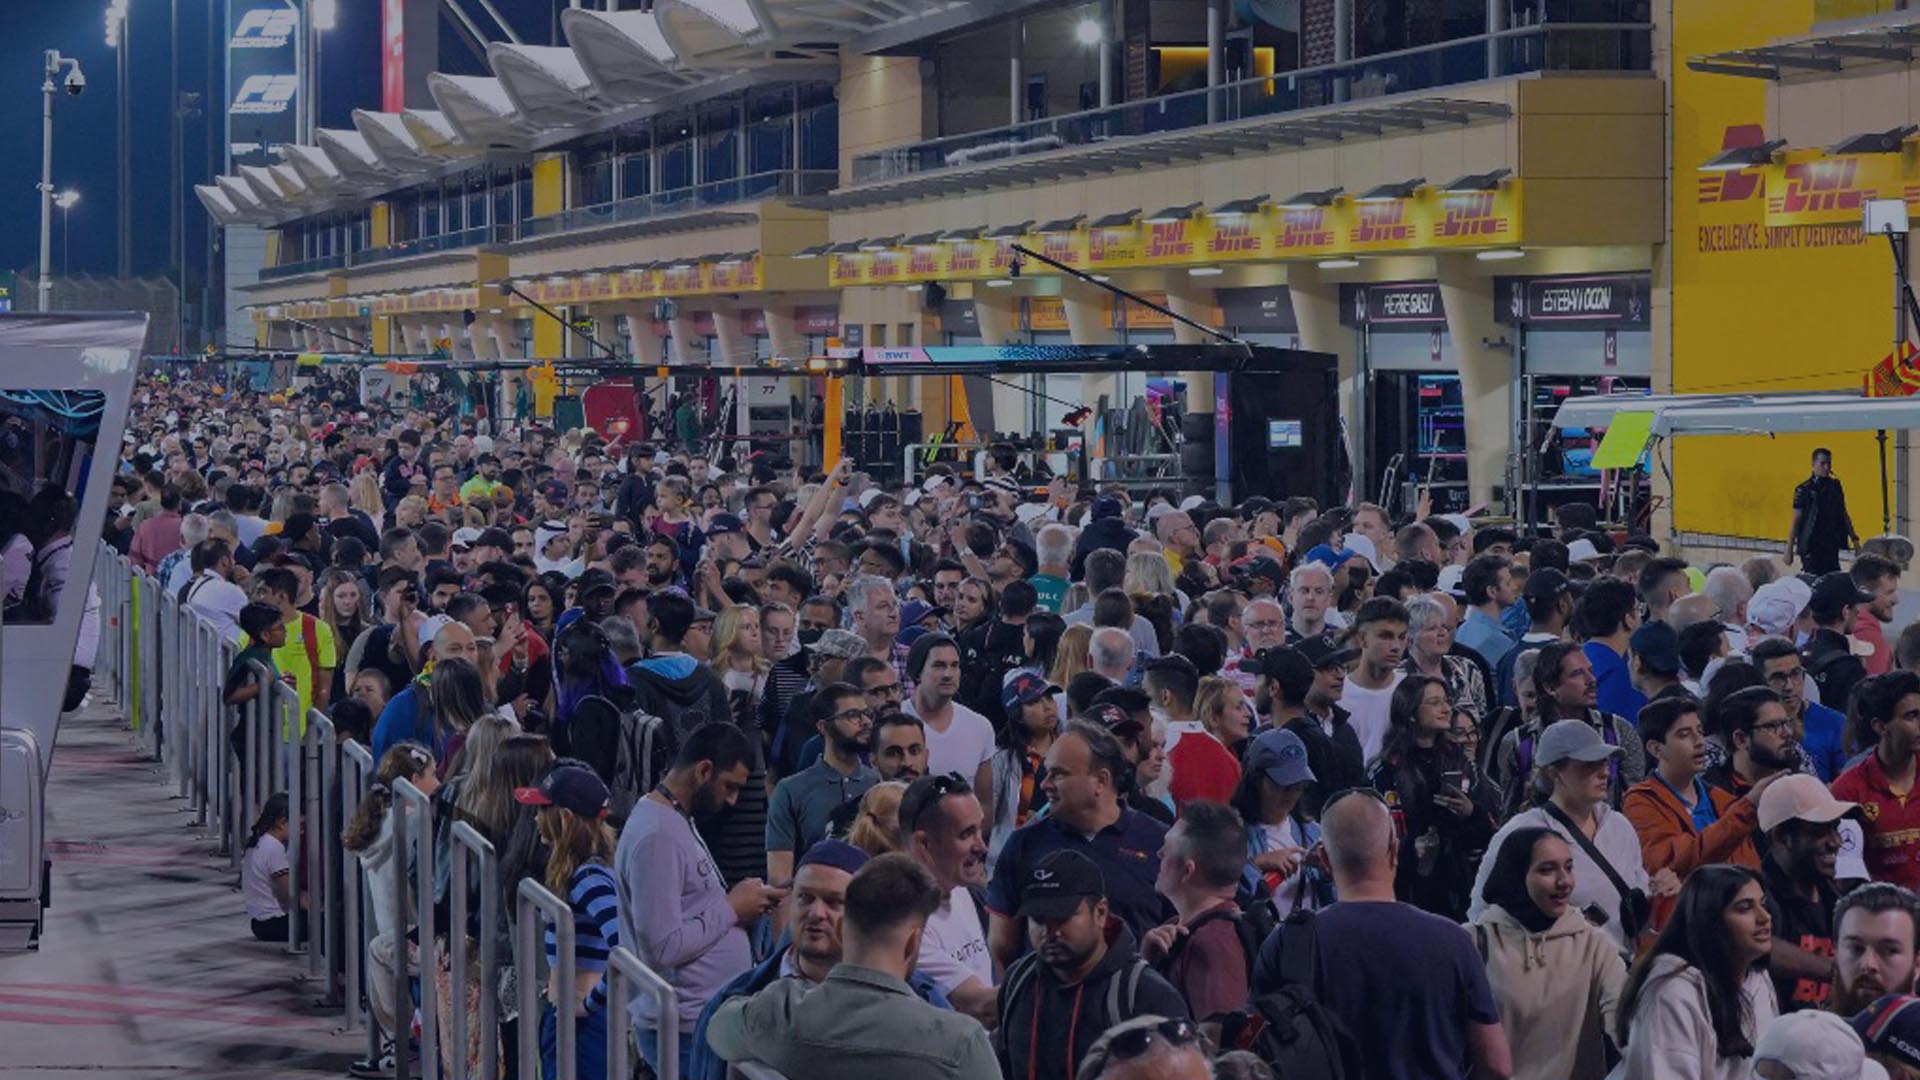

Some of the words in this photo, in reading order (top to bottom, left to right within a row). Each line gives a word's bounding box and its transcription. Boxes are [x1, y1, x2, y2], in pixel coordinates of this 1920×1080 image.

[1783, 158, 1861, 213] DHL
[1360, 201, 1407, 242] DHL
[1445, 190, 1499, 236] DHL
[1542, 288, 1583, 312] ESTEBAN
[1584, 286, 1612, 310] OCON
